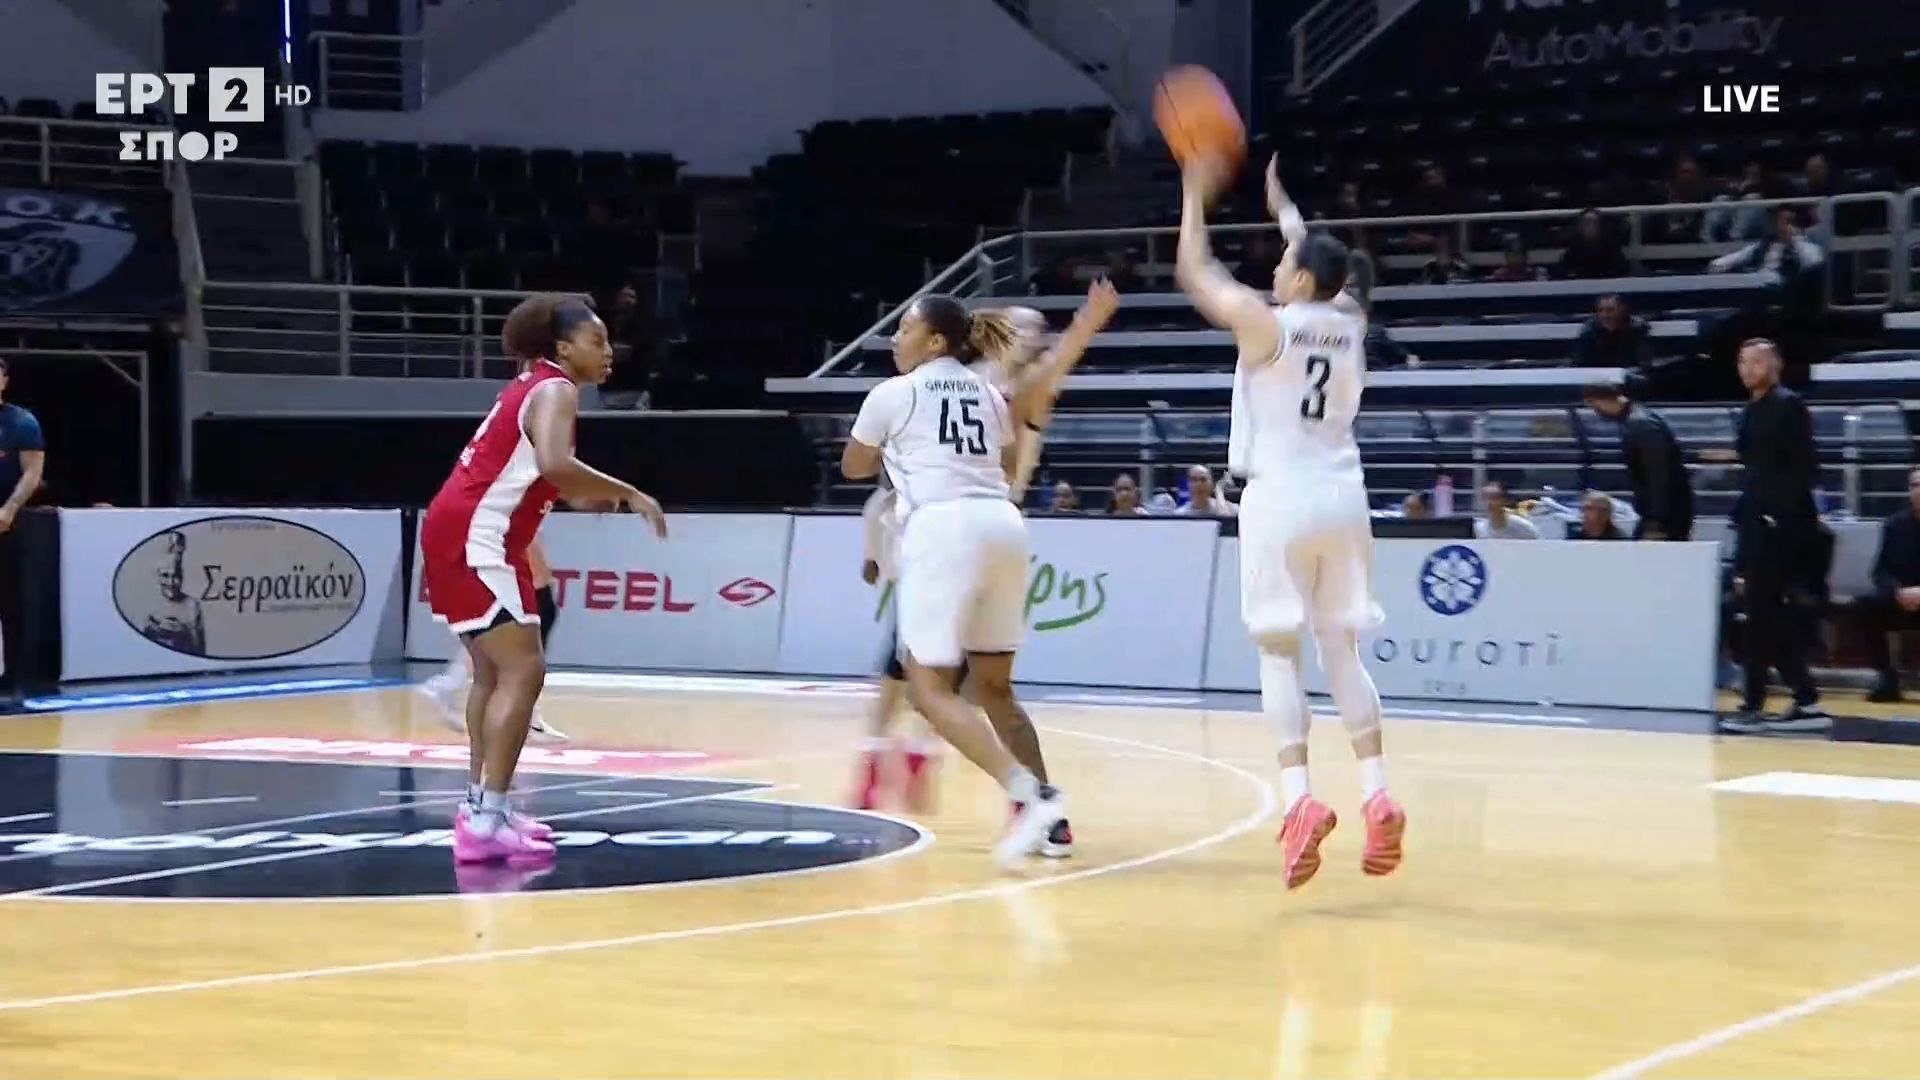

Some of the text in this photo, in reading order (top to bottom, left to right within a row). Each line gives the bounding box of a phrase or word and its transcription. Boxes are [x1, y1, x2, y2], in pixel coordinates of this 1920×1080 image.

[924, 378, 980, 395] GRAYSON
[1301, 353, 1331, 420] 3
[938, 397, 988, 455] 45
